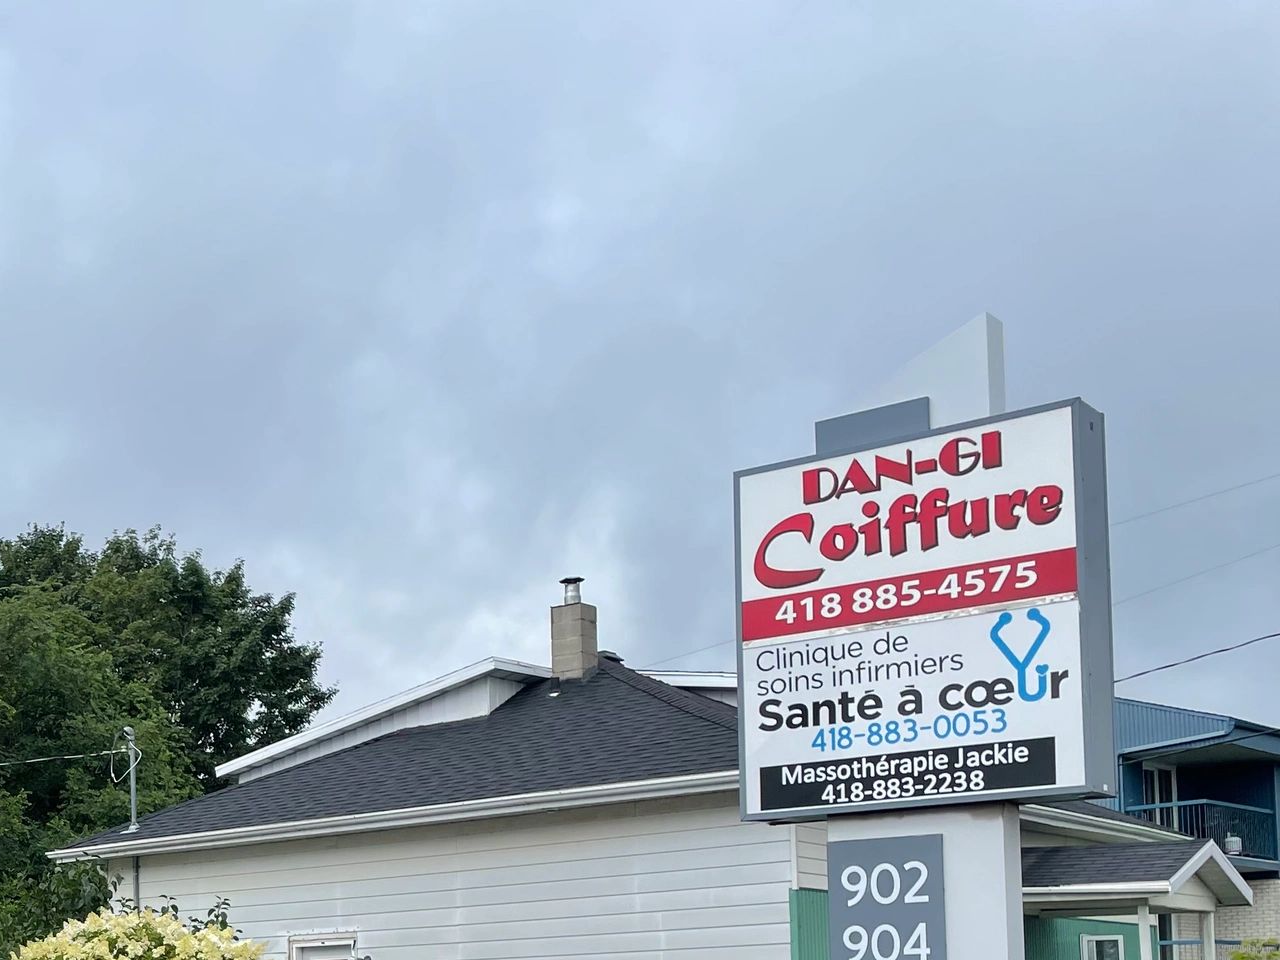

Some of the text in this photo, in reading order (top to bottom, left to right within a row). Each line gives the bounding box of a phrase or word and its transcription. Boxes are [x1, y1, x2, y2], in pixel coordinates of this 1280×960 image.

[802, 431, 1002, 505] DAN-GI
[753, 485, 1064, 589] Coiffure
[775, 561, 1039, 624] 418 885-4575
[756, 631, 910, 676] Clinique de
[757, 653, 964, 697] soins infirmiers
[811, 708, 1008, 752] 418-883-0053
[781, 743, 1029, 786] Massothérapie Jackie
[821, 770, 985, 804] 418-883-2238
[840, 861, 929, 907] 902
